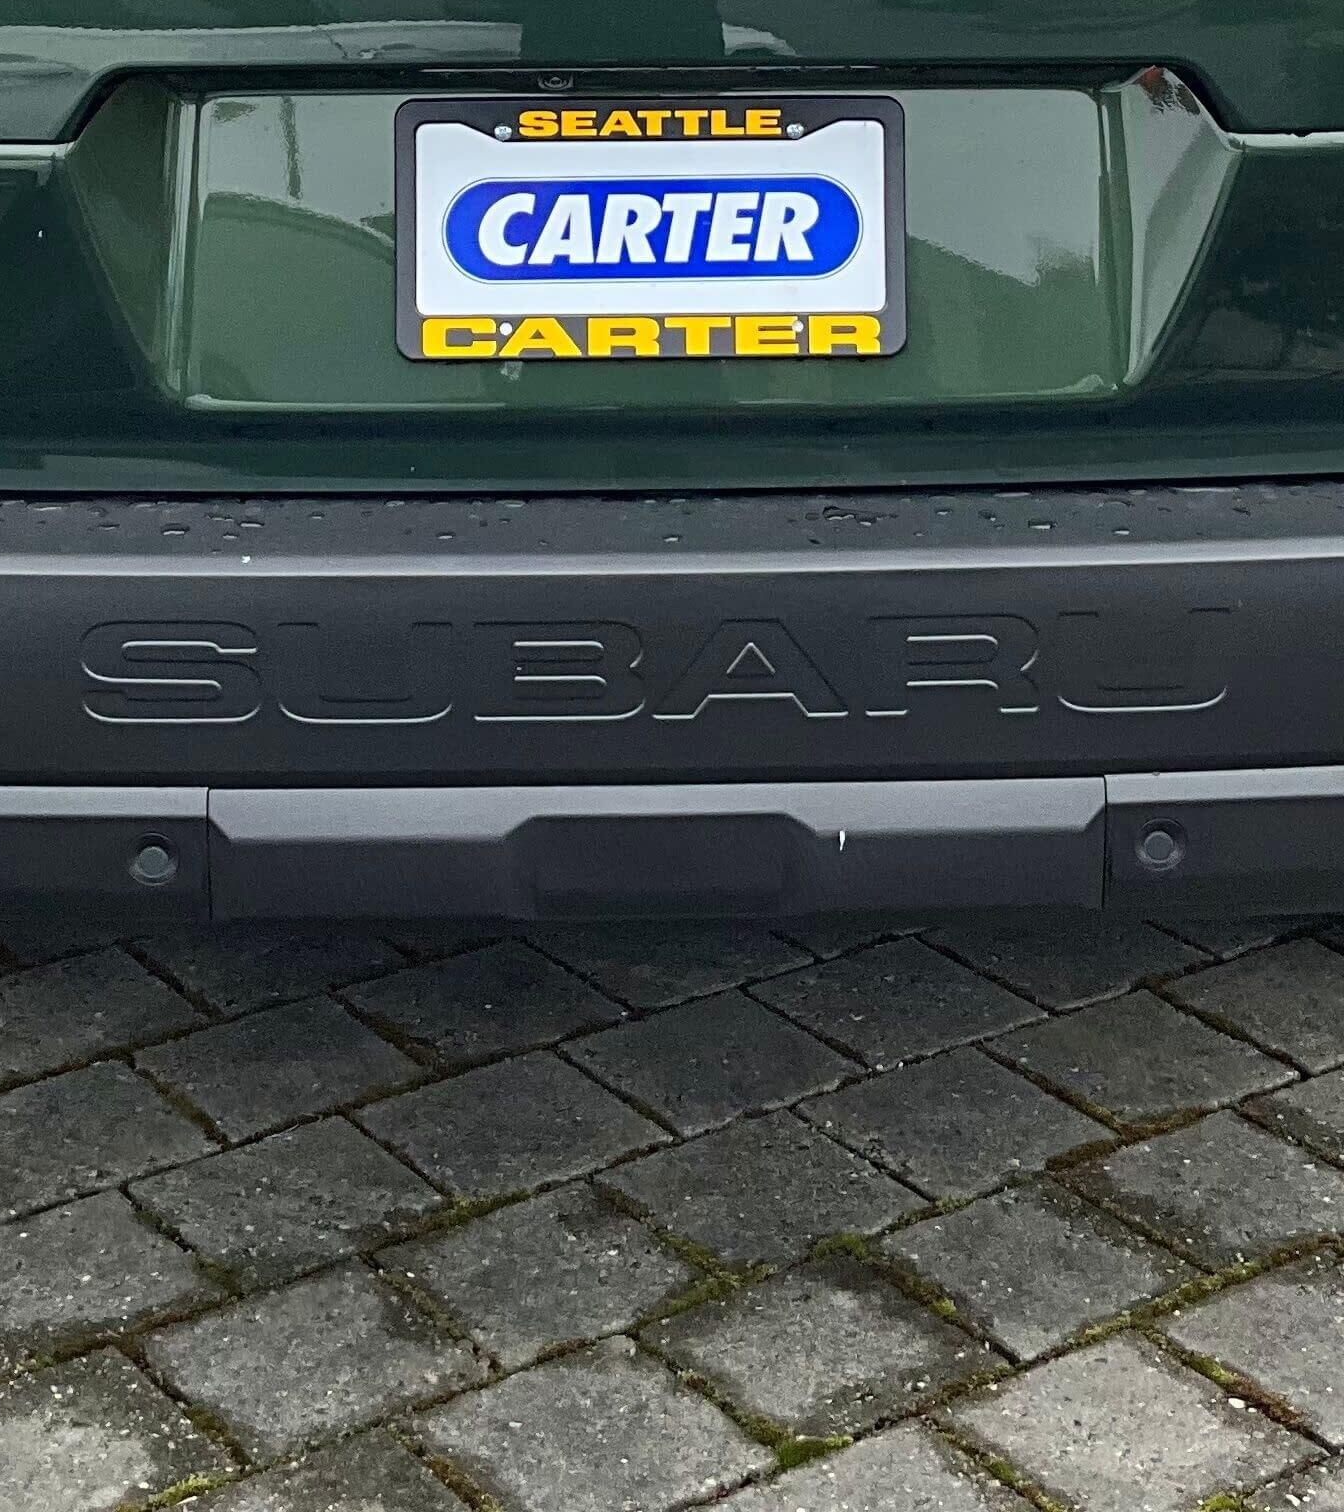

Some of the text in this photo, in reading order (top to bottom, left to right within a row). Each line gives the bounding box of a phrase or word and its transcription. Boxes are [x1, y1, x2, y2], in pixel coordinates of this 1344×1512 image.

[518, 108, 782, 138] SEATTLE
[477, 191, 820, 266] CARTER
[422, 315, 881, 357] CARTER
[80, 608, 1230, 724] SUBARU
